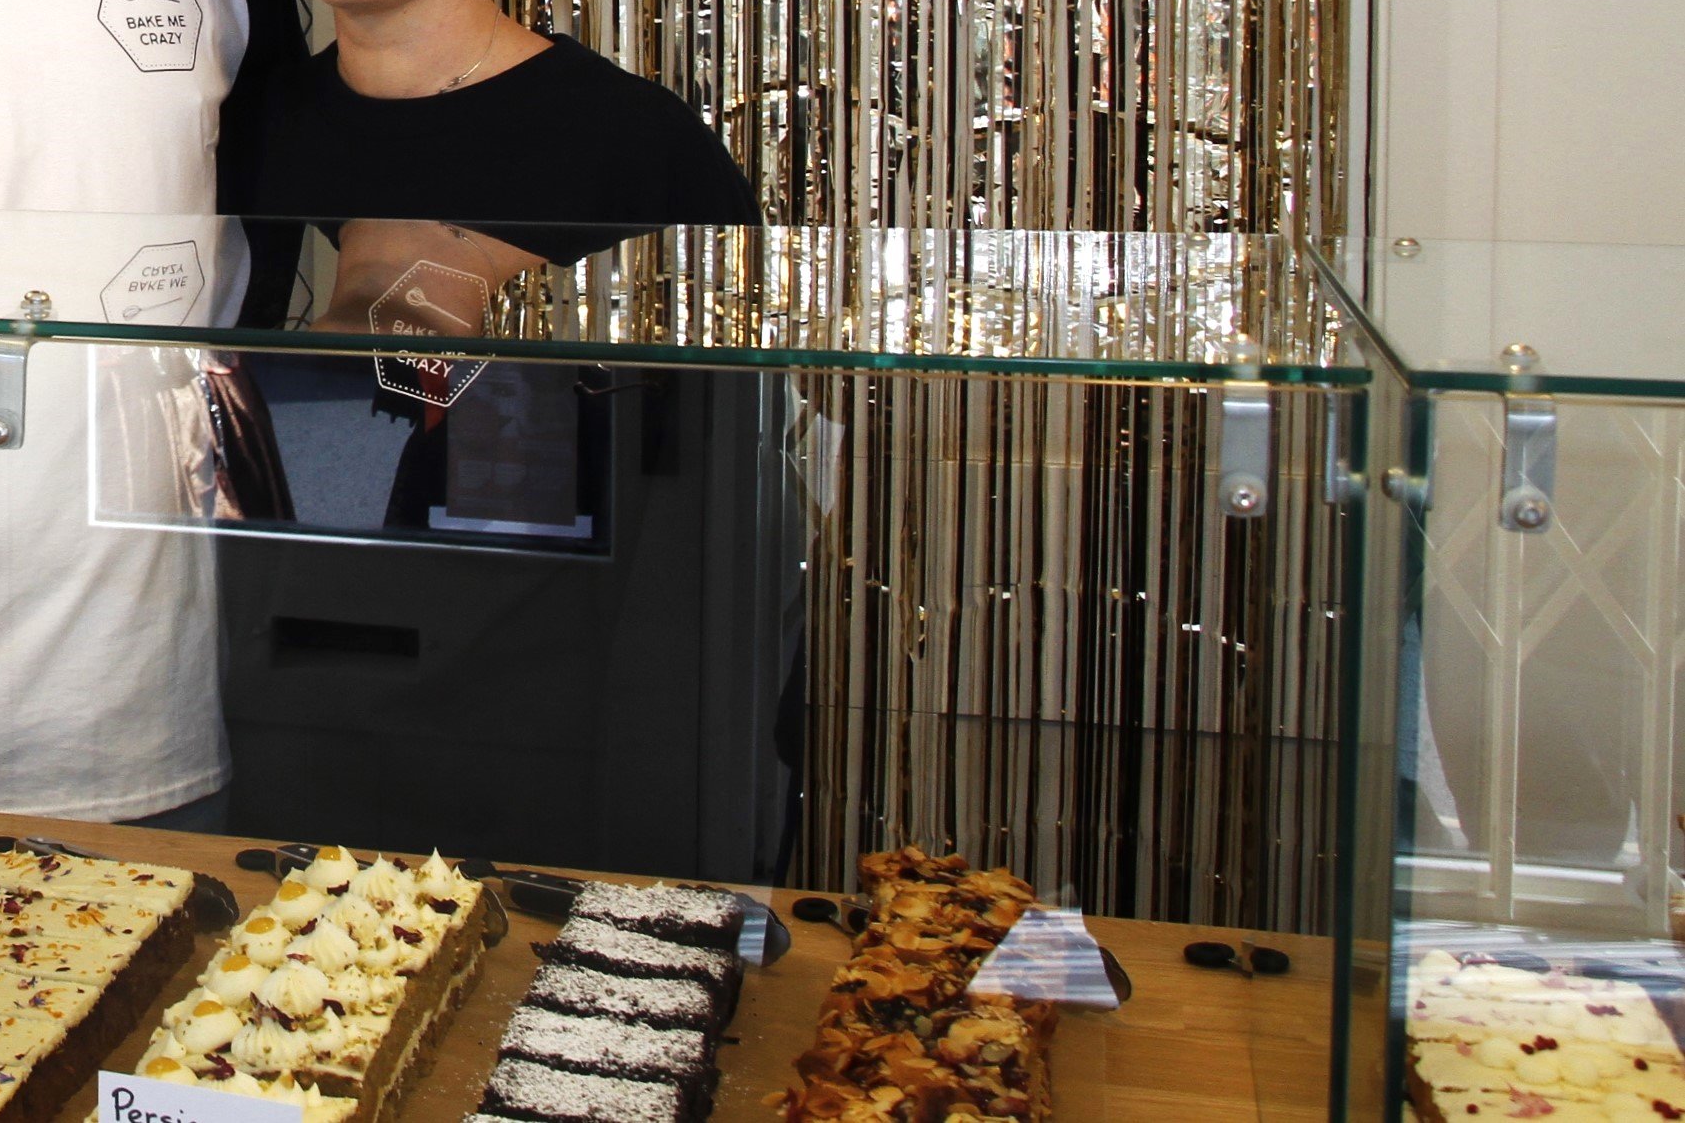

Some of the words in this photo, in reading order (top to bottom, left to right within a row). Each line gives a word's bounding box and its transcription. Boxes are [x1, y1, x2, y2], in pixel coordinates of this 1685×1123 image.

[126, 15, 164, 29] BAKE
[167, 15, 186, 27] ME
[140, 32, 182, 45] CRAZY
[111, 1087, 197, 1123] Persi
